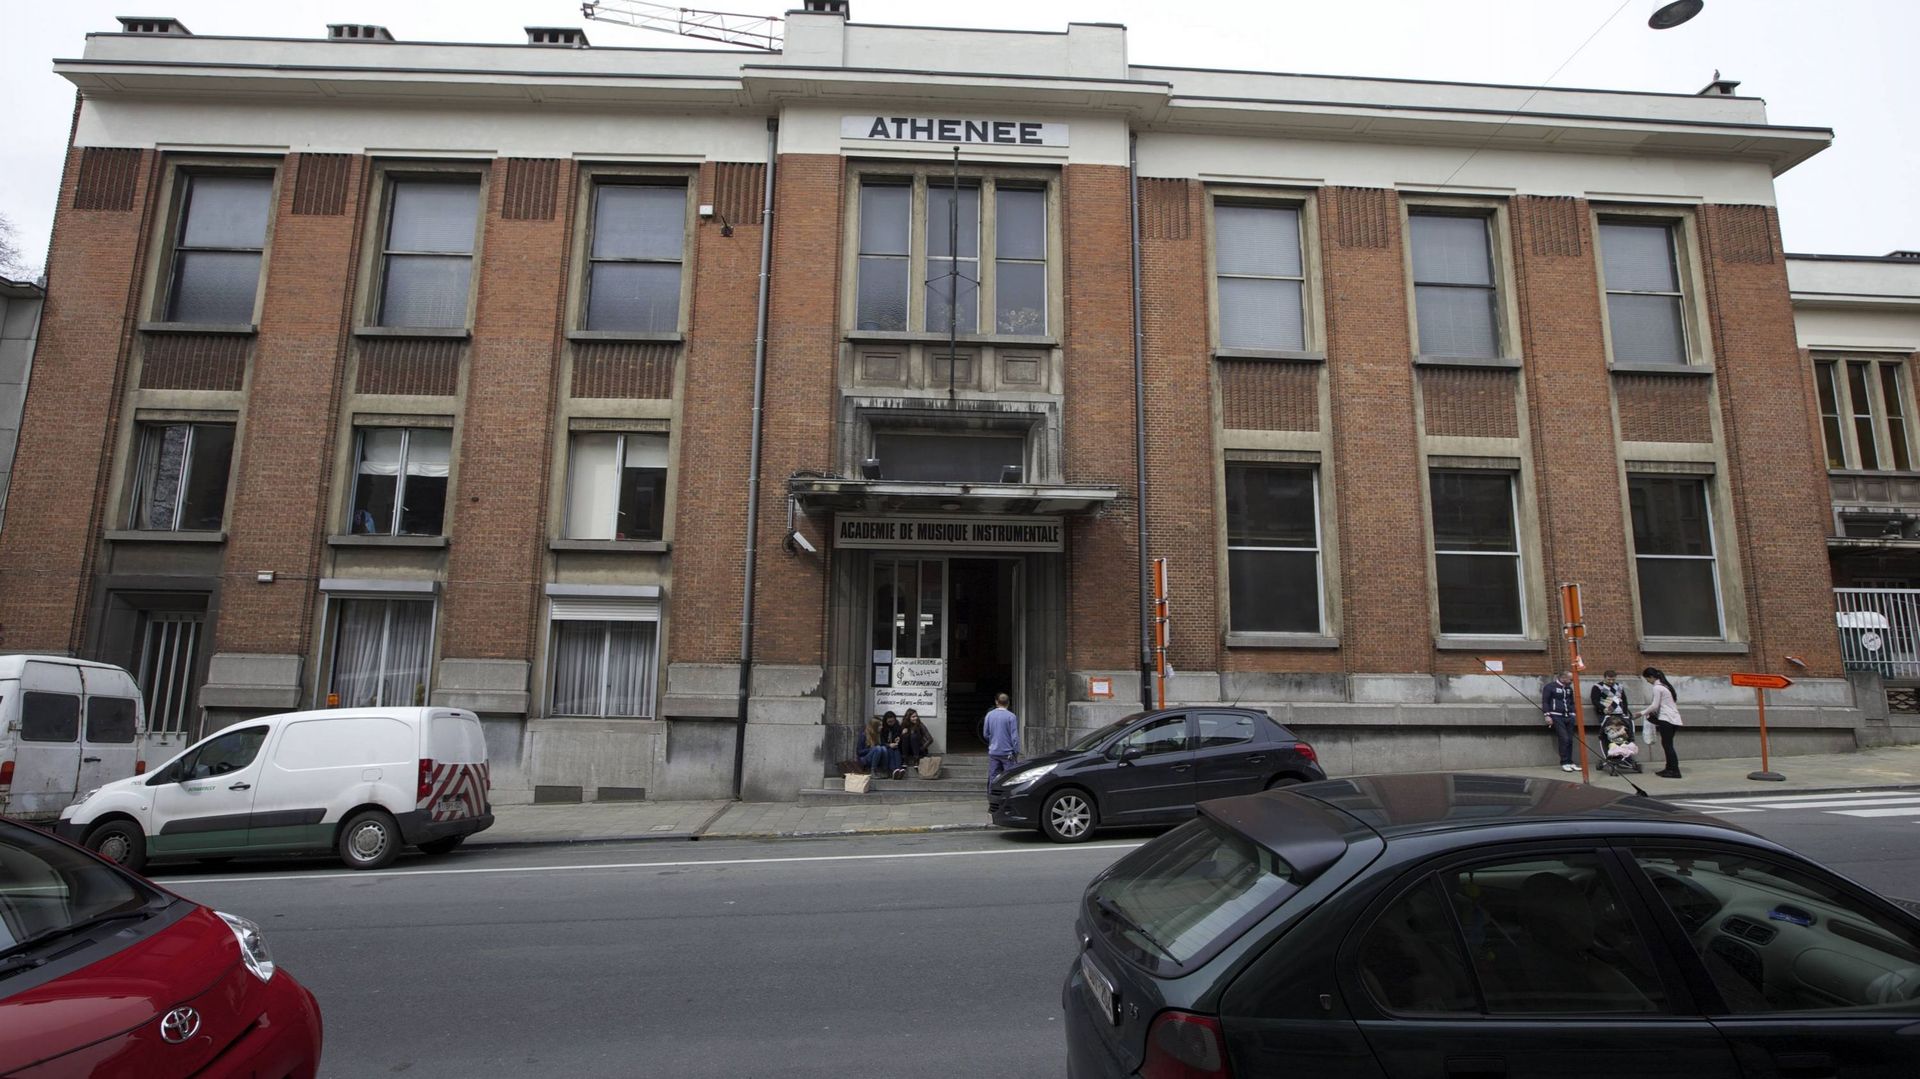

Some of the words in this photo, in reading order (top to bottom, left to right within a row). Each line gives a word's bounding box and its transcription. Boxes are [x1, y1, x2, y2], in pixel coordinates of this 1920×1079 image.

[868, 116, 1043, 145] ATHENEE
[840, 521, 896, 540] ACADEMIE
[900, 522, 914, 540] DE
[917, 523, 968, 542] MUSIQUE
[972, 524, 1059, 543] INSTRUMENTALE
